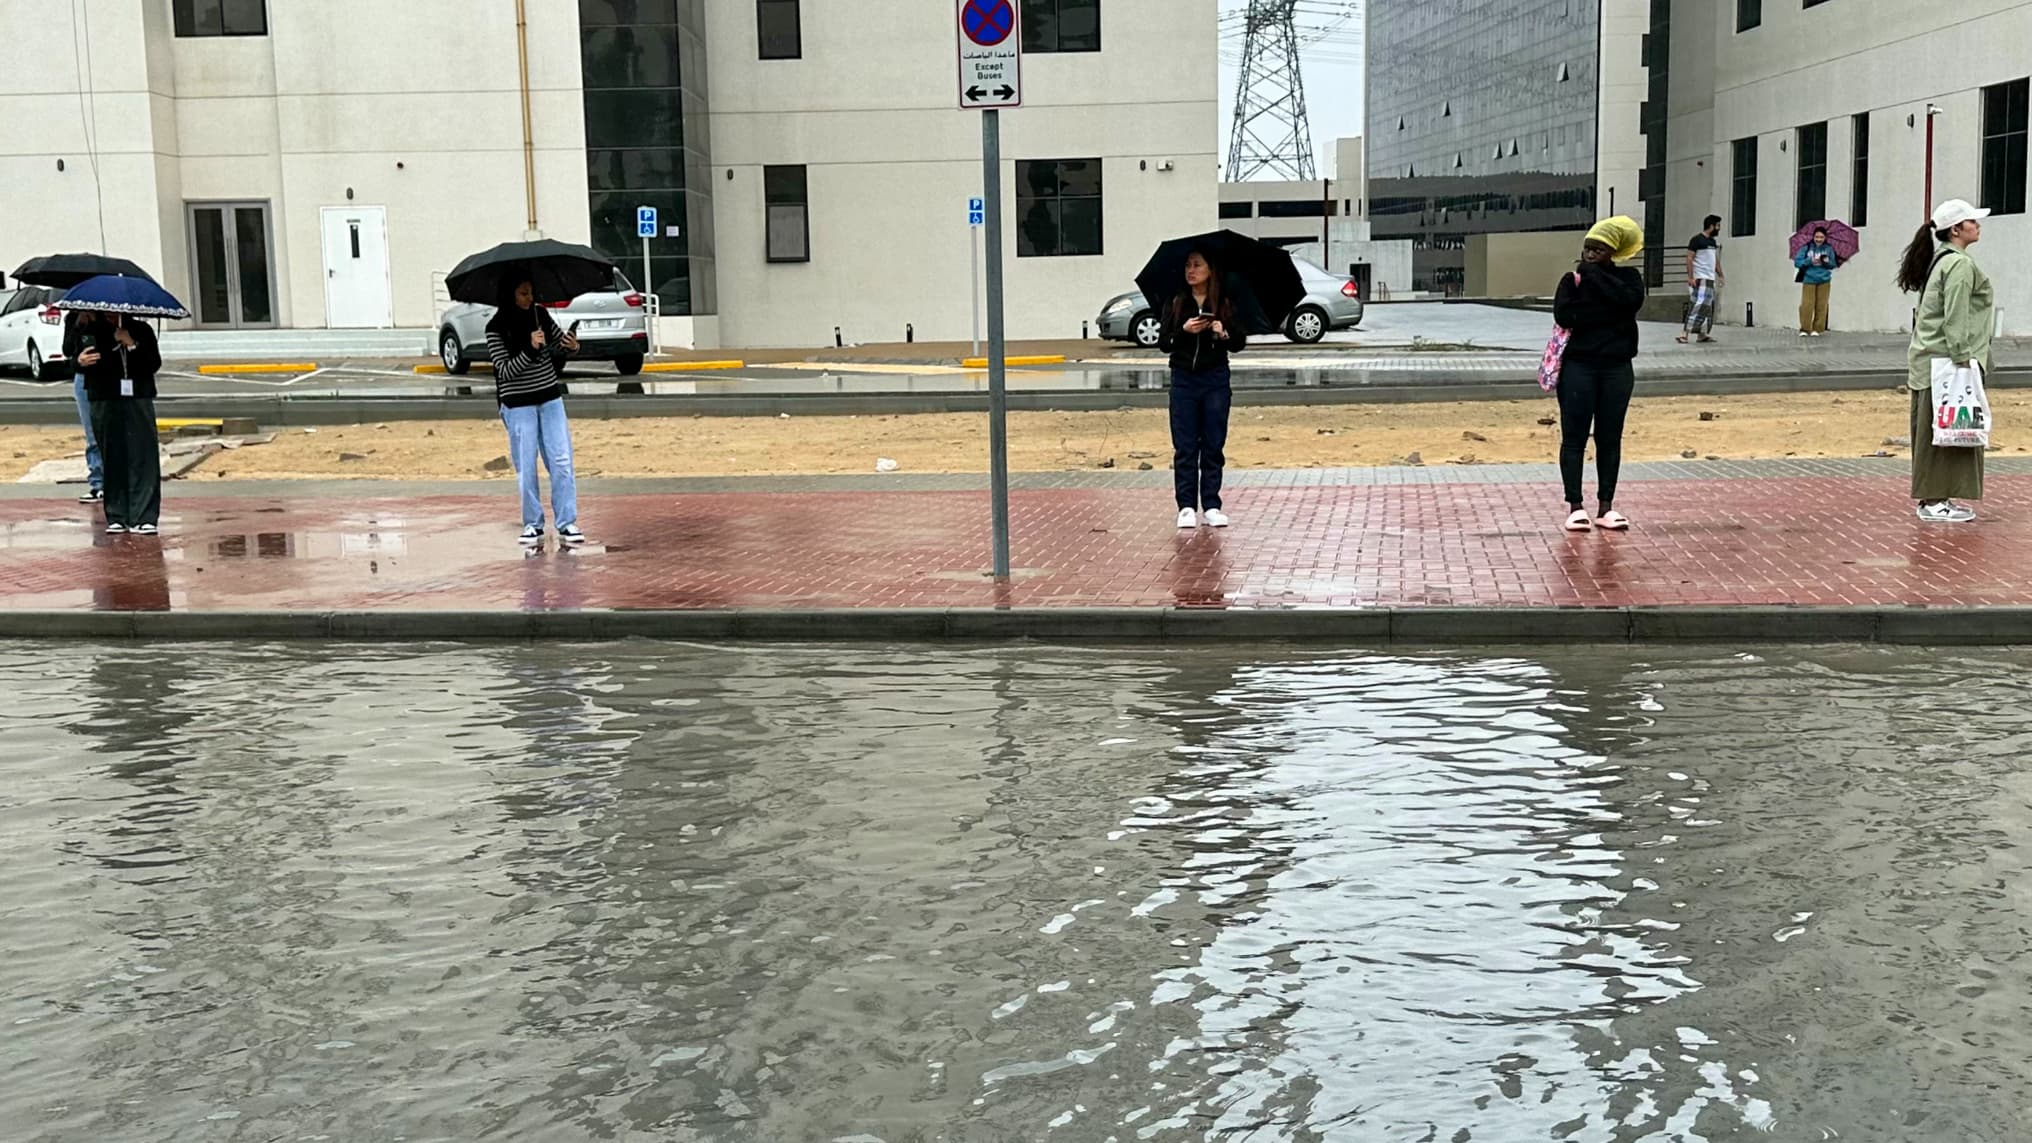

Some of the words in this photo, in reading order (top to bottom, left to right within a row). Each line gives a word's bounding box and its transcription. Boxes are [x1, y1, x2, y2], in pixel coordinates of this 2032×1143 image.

[963, 51, 993, 60] الباصات
[975, 62, 1004, 71] Except
[977, 72, 1002, 80] Buses
[1938, 406, 1984, 429] UAE
